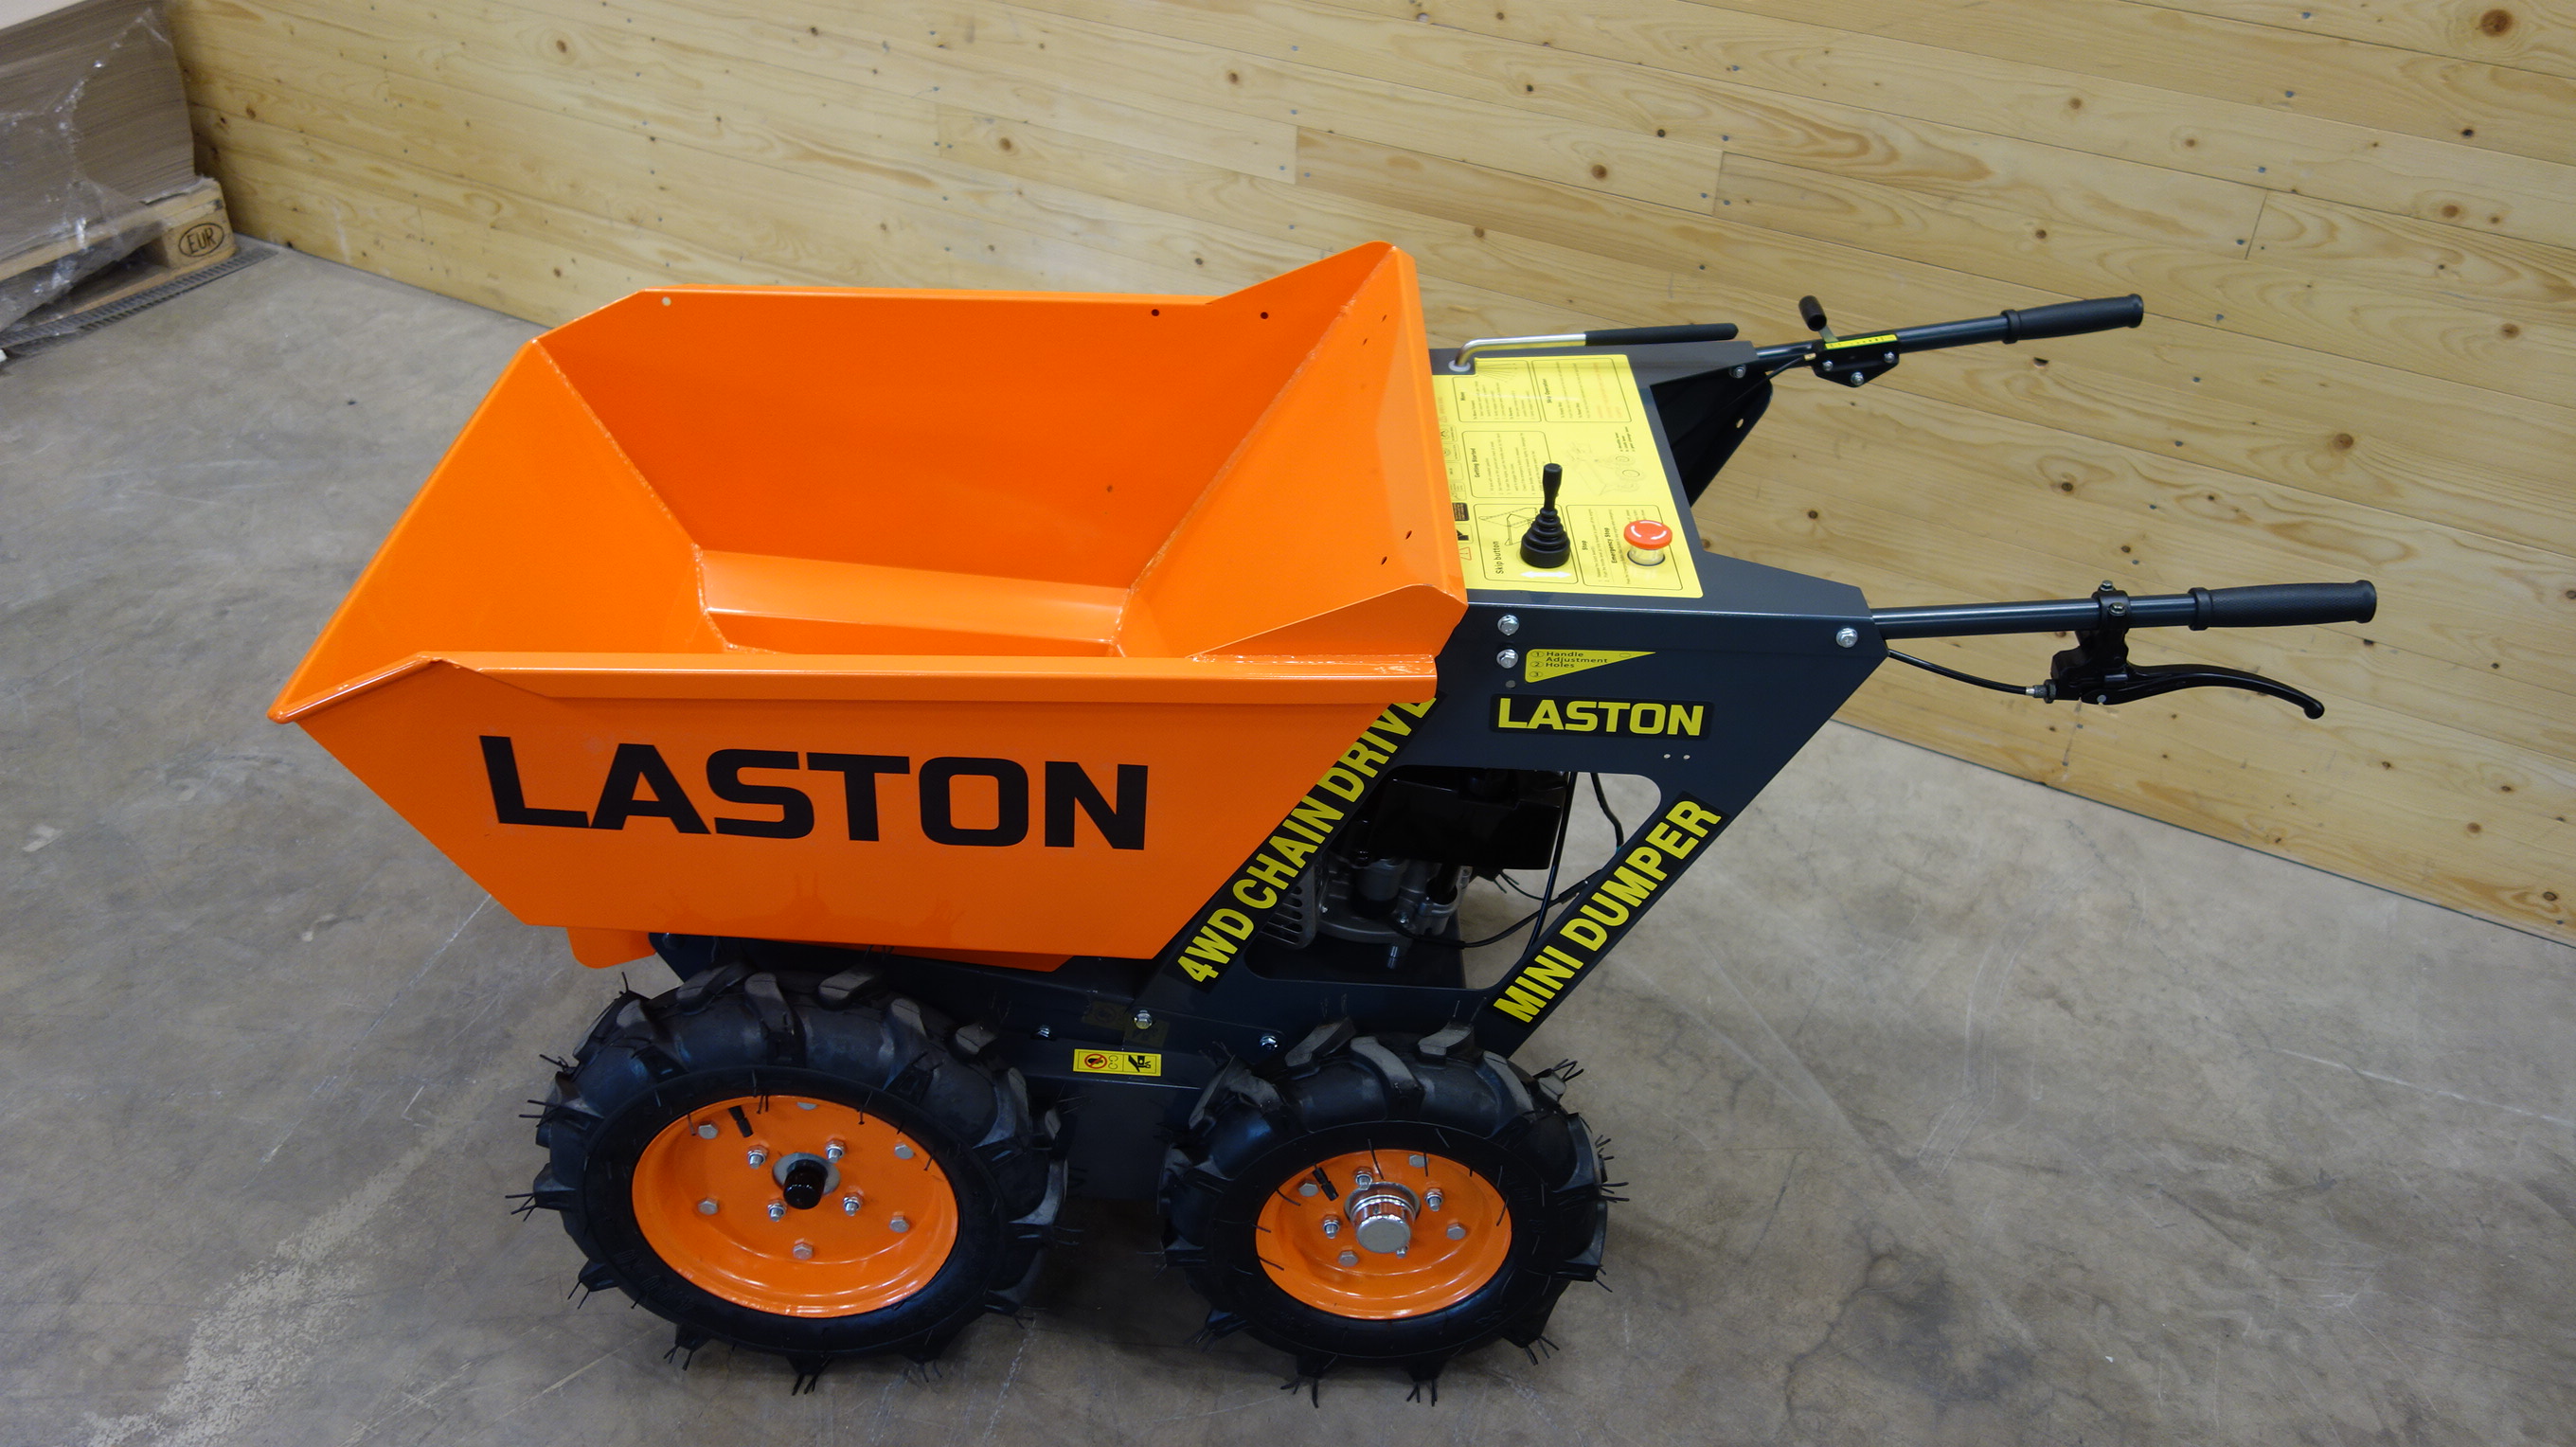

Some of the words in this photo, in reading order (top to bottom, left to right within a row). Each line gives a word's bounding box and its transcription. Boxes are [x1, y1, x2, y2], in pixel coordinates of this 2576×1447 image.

[187, 227, 217, 255] EUR
[1493, 541, 1501, 560] button
[1607, 539, 1618, 563] Emergency
[1495, 562, 1504, 574] Skip
[1498, 698, 1704, 736] LASTON
[479, 735, 1149, 850] LASTON
[1177, 908, 1255, 982] 4WD
[1232, 795, 1345, 909] CHAIN
[1493, 945, 1583, 1023] MINI
[1559, 800, 1722, 952] DUMPER
